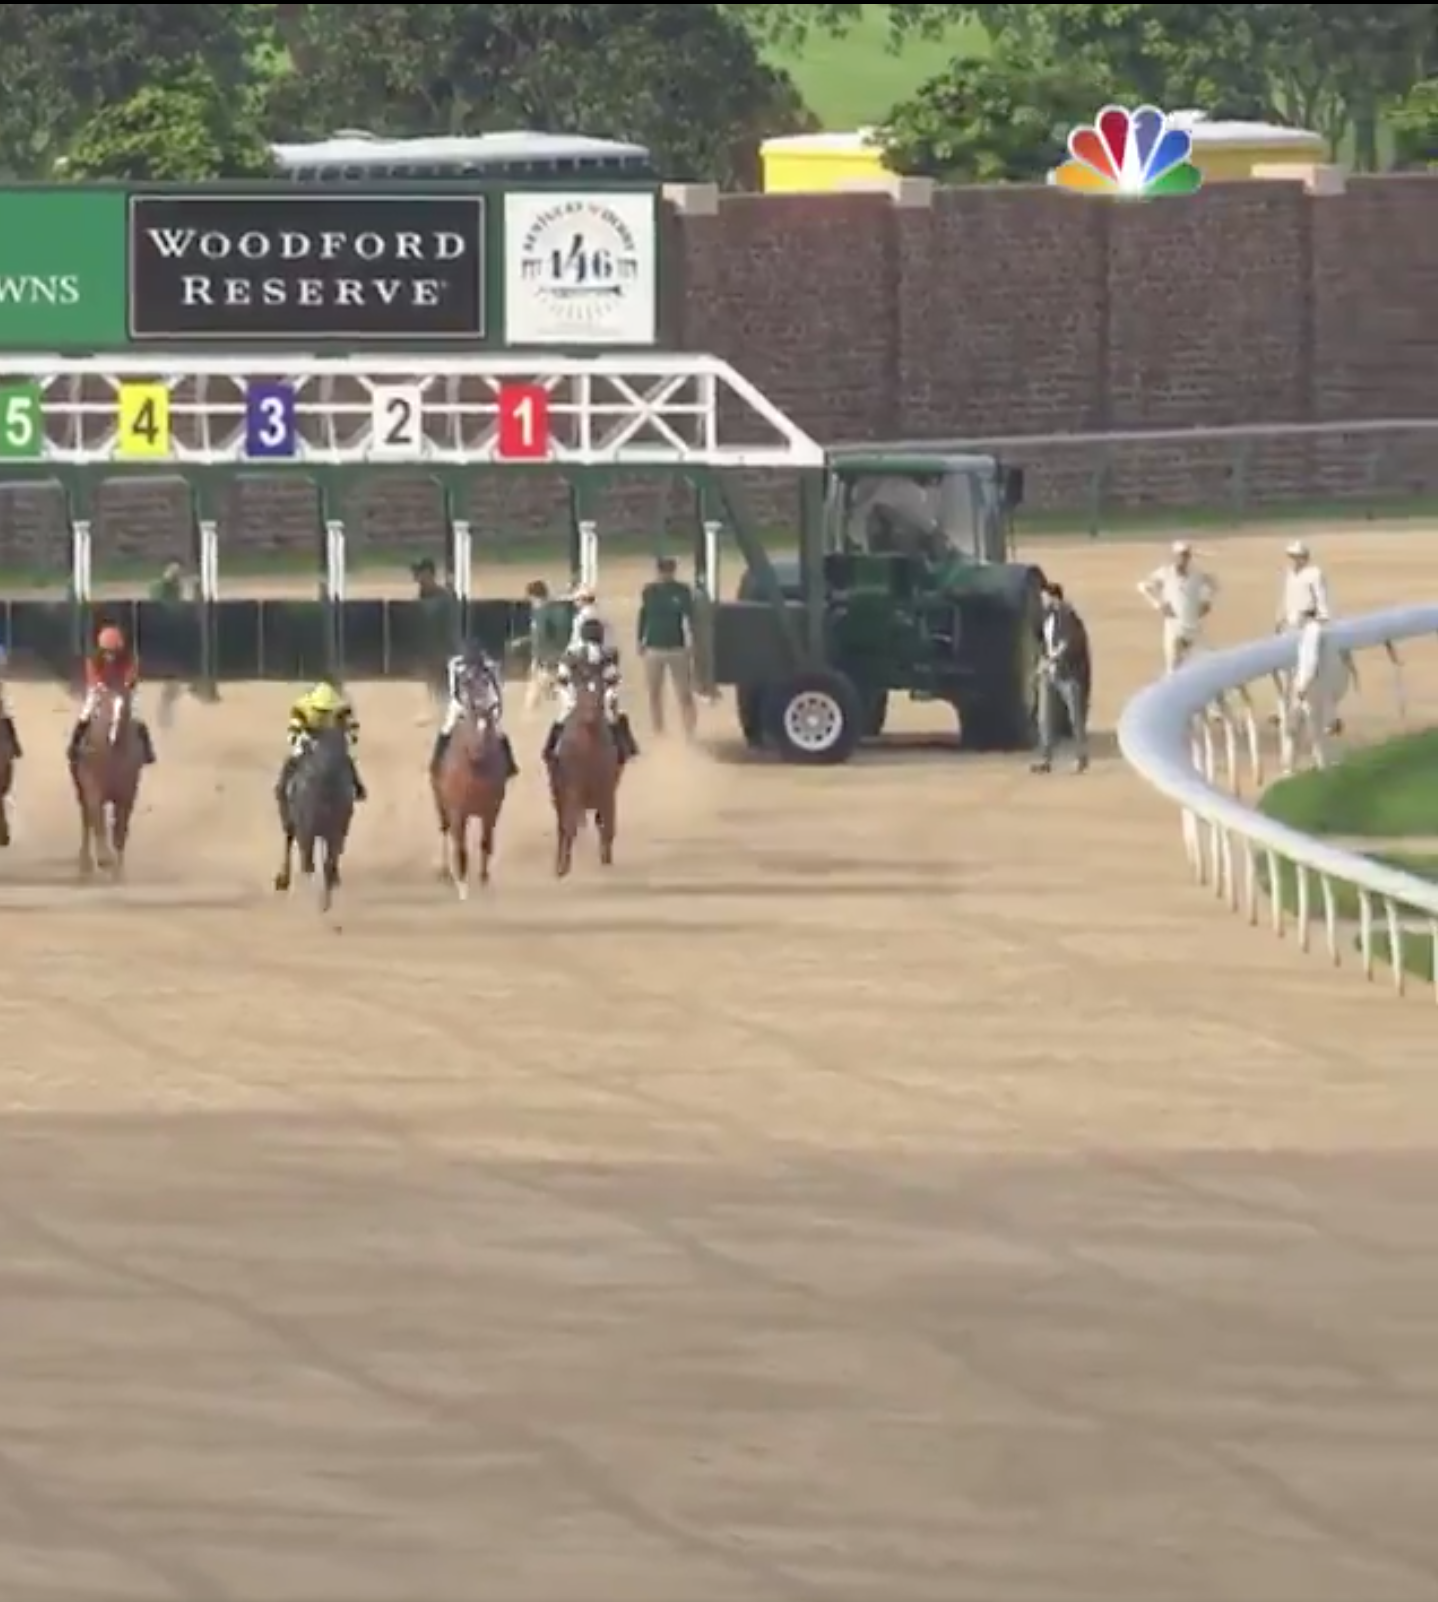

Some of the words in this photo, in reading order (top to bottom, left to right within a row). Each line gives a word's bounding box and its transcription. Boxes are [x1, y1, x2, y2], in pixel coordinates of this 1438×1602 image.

[148, 227, 467, 260] WOODFORD
[551, 233, 613, 283] 146
[181, 274, 442, 305] RESERVE
[5, 397, 32, 446] 5
[132, 398, 159, 445] 4
[258, 397, 287, 446] 3
[384, 398, 412, 444] 2
[512, 396, 533, 446] 1
